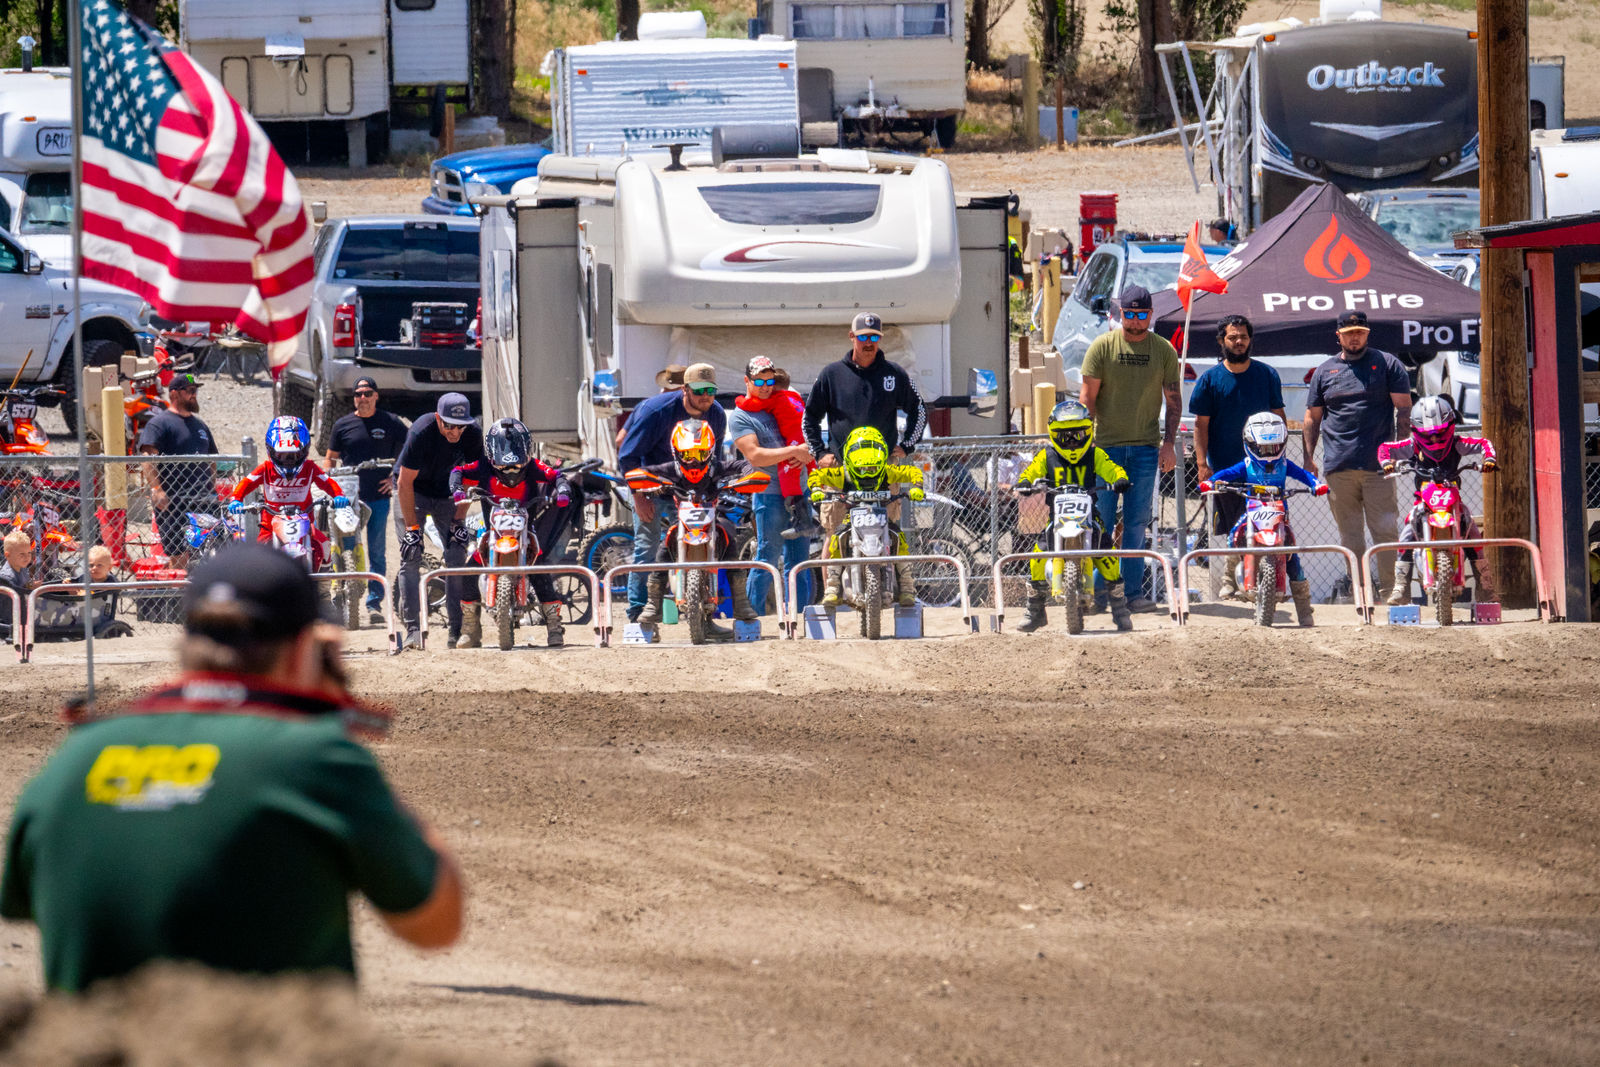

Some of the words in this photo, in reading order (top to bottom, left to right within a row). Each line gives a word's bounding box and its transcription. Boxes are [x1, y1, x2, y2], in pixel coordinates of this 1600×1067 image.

[1307, 60, 1445, 91] Outback
[1262, 292, 1334, 312] Pro
[1343, 288, 1424, 310] Fire
[1402, 319, 1454, 345] Pro
[1054, 466, 1087, 487] FLY
[1429, 490, 1452, 506] 54
[686, 509, 710, 522] 3
[1057, 502, 1088, 514] 124
[1253, 511, 1275, 520] 007
[286, 521, 298, 536] 3
[494, 514, 525, 531] 129
